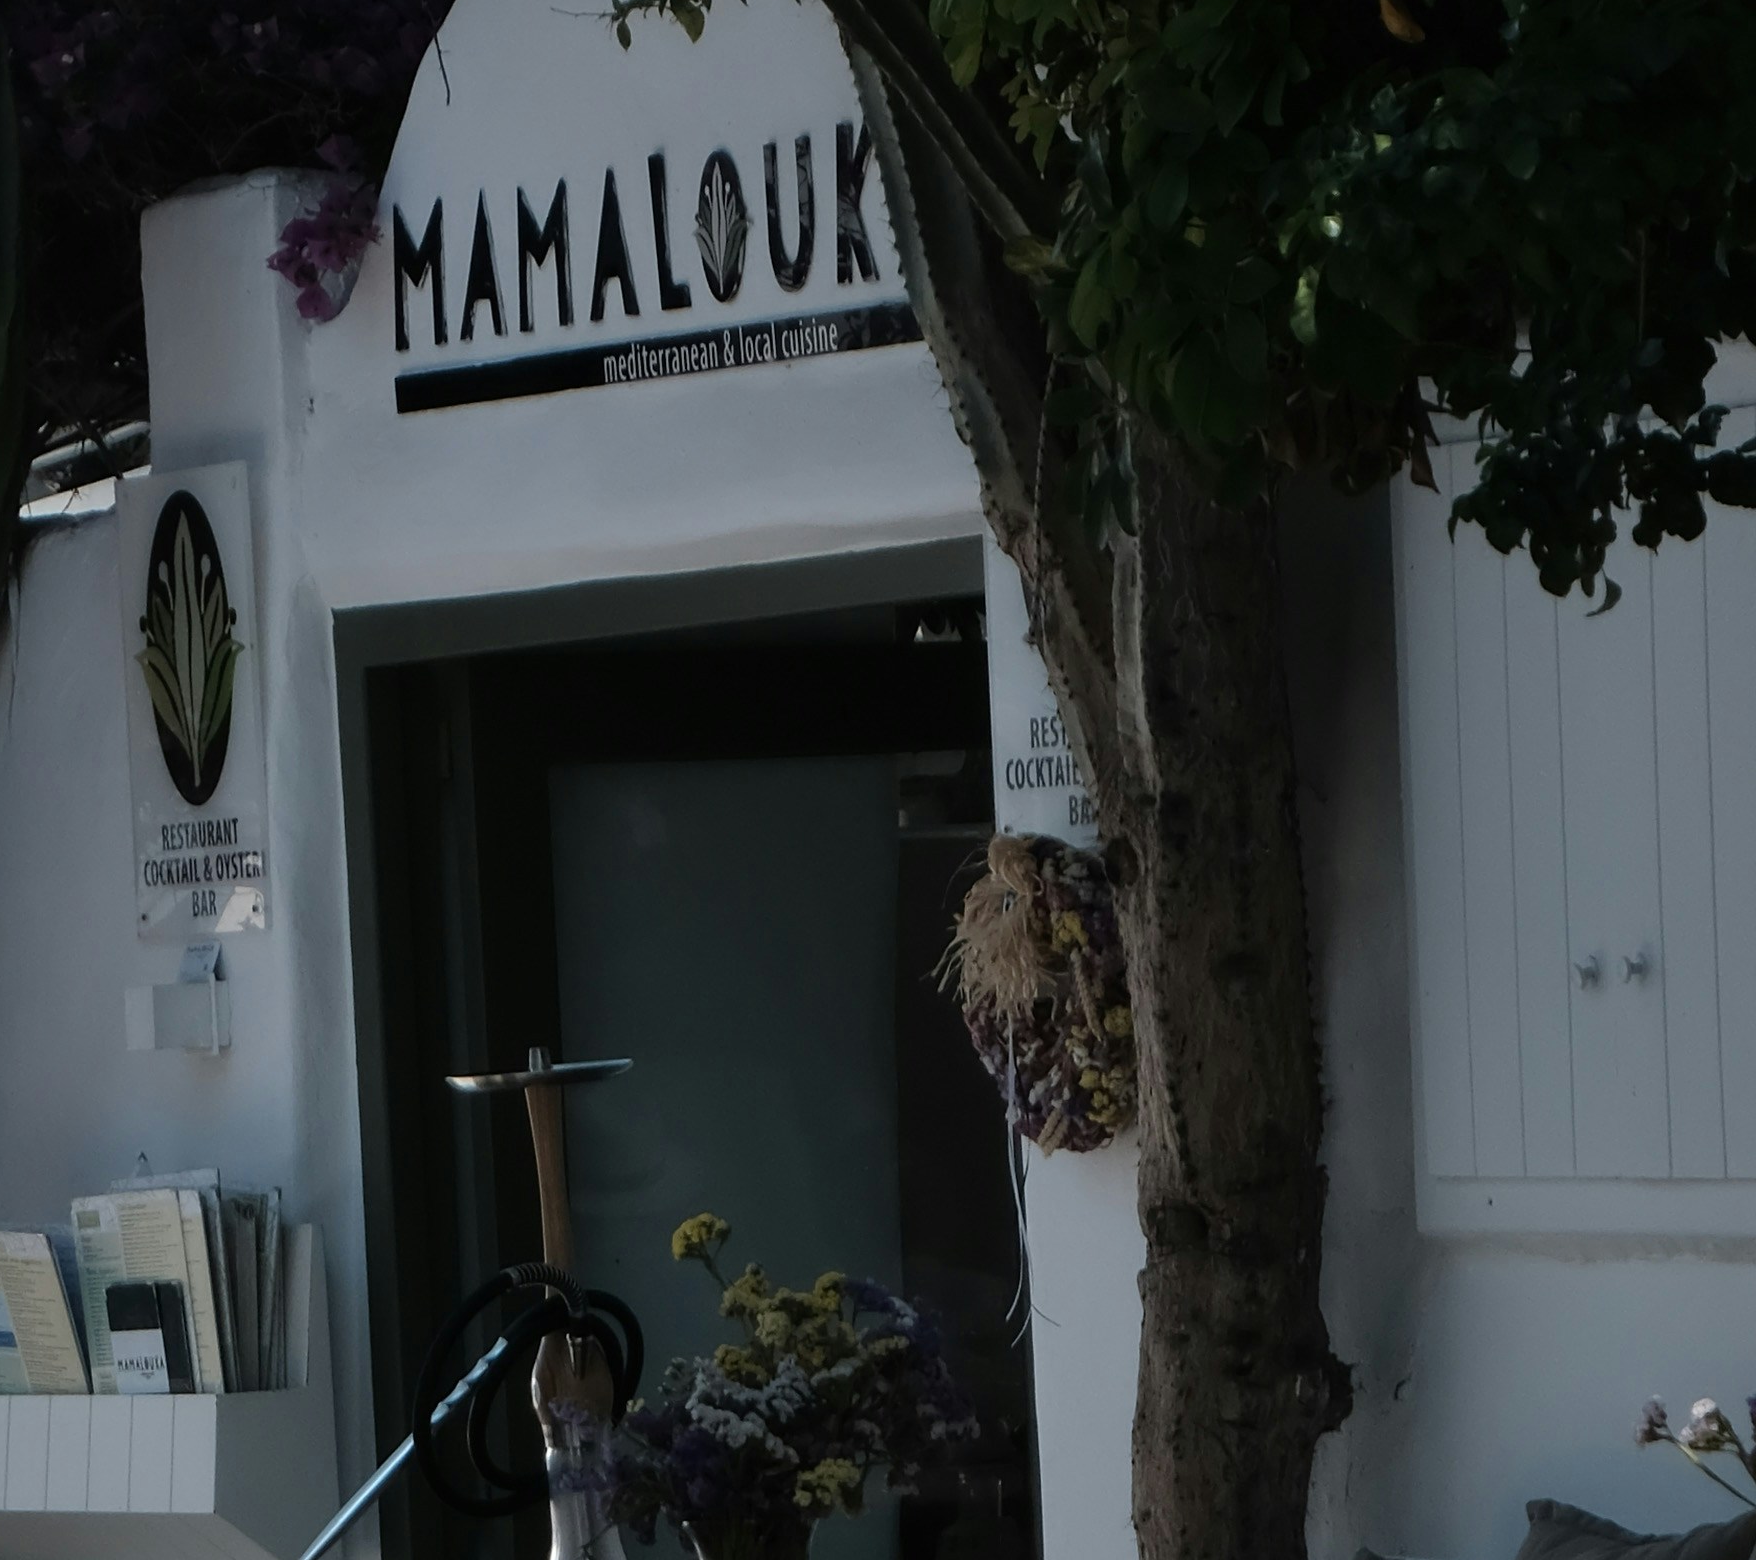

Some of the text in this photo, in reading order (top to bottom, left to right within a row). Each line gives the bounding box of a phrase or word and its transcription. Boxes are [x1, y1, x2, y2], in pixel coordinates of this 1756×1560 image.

[393, 120, 881, 351] MAMALOUK
[603, 318, 839, 383] mediterranean & local cuisine
[1068, 794, 1093, 826] BA
[162, 818, 238, 850] RESTAURANT
[144, 851, 260, 886] COCKTAIL & OYSTER
[193, 890, 217, 917] BAR
